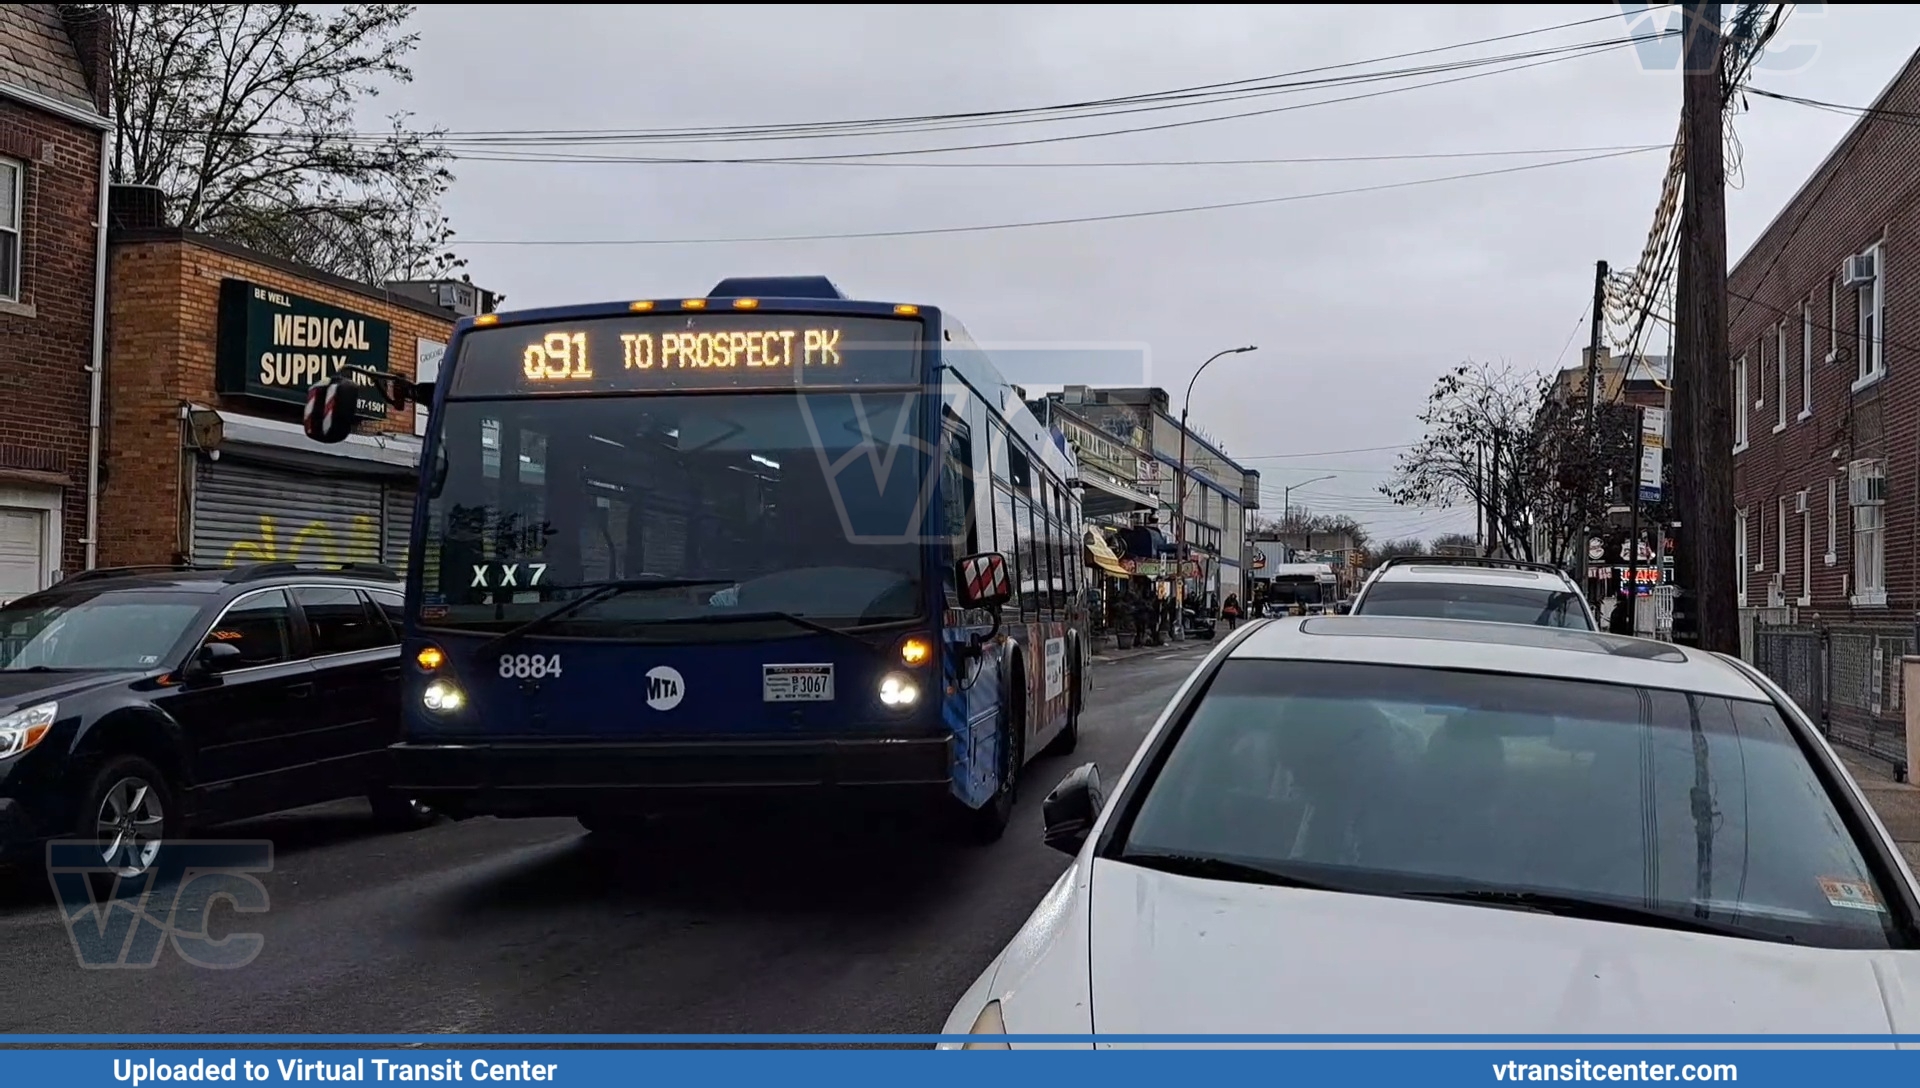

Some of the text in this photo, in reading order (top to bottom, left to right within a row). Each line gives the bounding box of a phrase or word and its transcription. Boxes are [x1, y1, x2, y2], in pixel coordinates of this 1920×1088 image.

[254, 288, 292, 307] BE WELL
[273, 313, 370, 350] MEDICAL
[620, 334, 653, 370] TO
[661, 330, 795, 368] PROSPECT
[804, 329, 840, 365] PK
[260, 351, 347, 385] SUPPLY
[470, 563, 547, 588] X X 7
[499, 654, 562, 678] 8884
[646, 676, 678, 701] MTA
[800, 675, 828, 693] 3067
